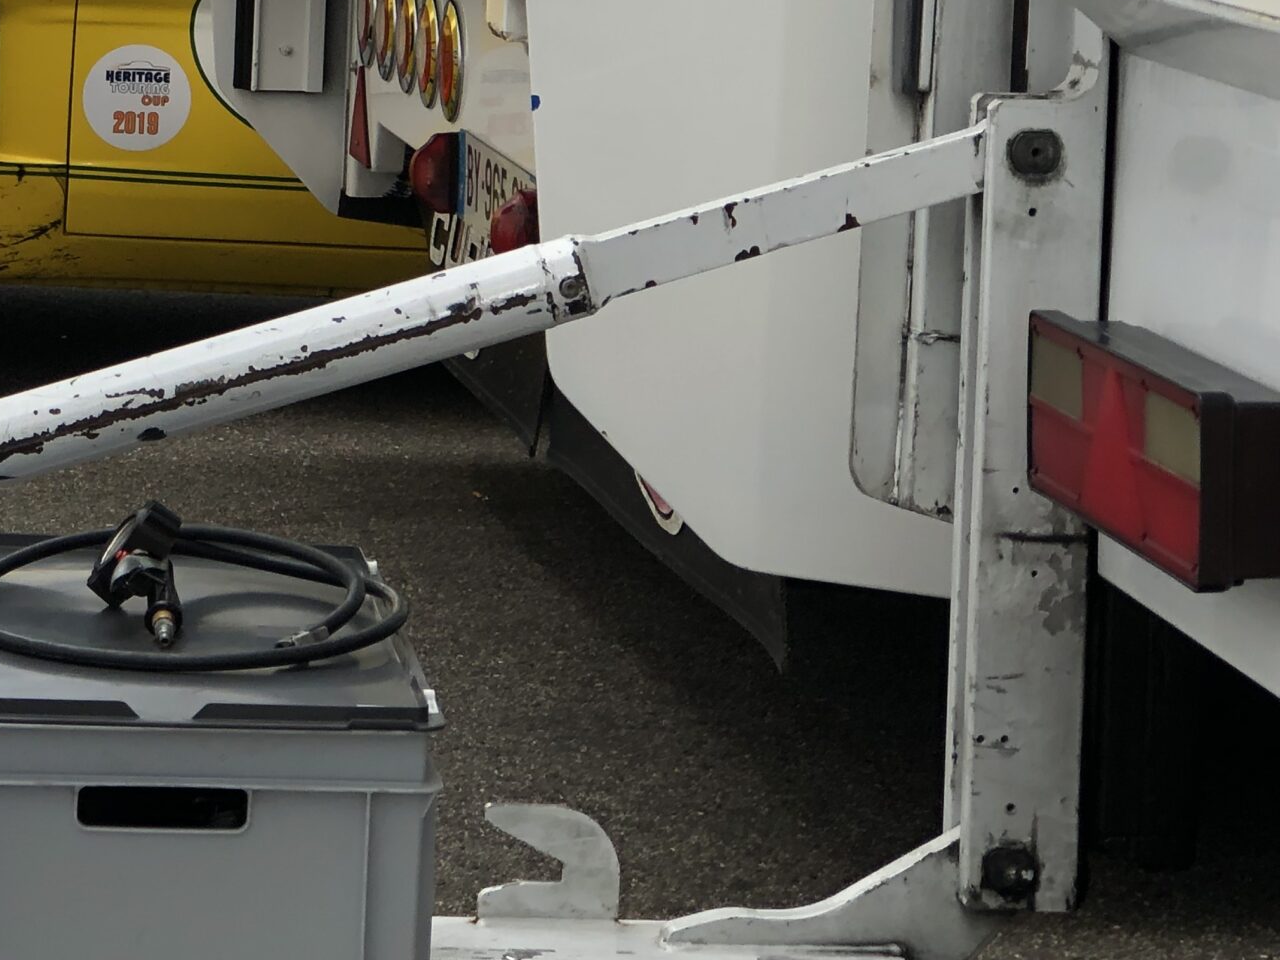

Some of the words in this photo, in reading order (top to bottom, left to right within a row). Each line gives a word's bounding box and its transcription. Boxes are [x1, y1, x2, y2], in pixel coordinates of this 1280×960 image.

[105, 69, 171, 84] HERITAGE
[109, 82, 170, 95] TOURING
[141, 94, 170, 107] CUP
[112, 110, 160, 135] 2019
